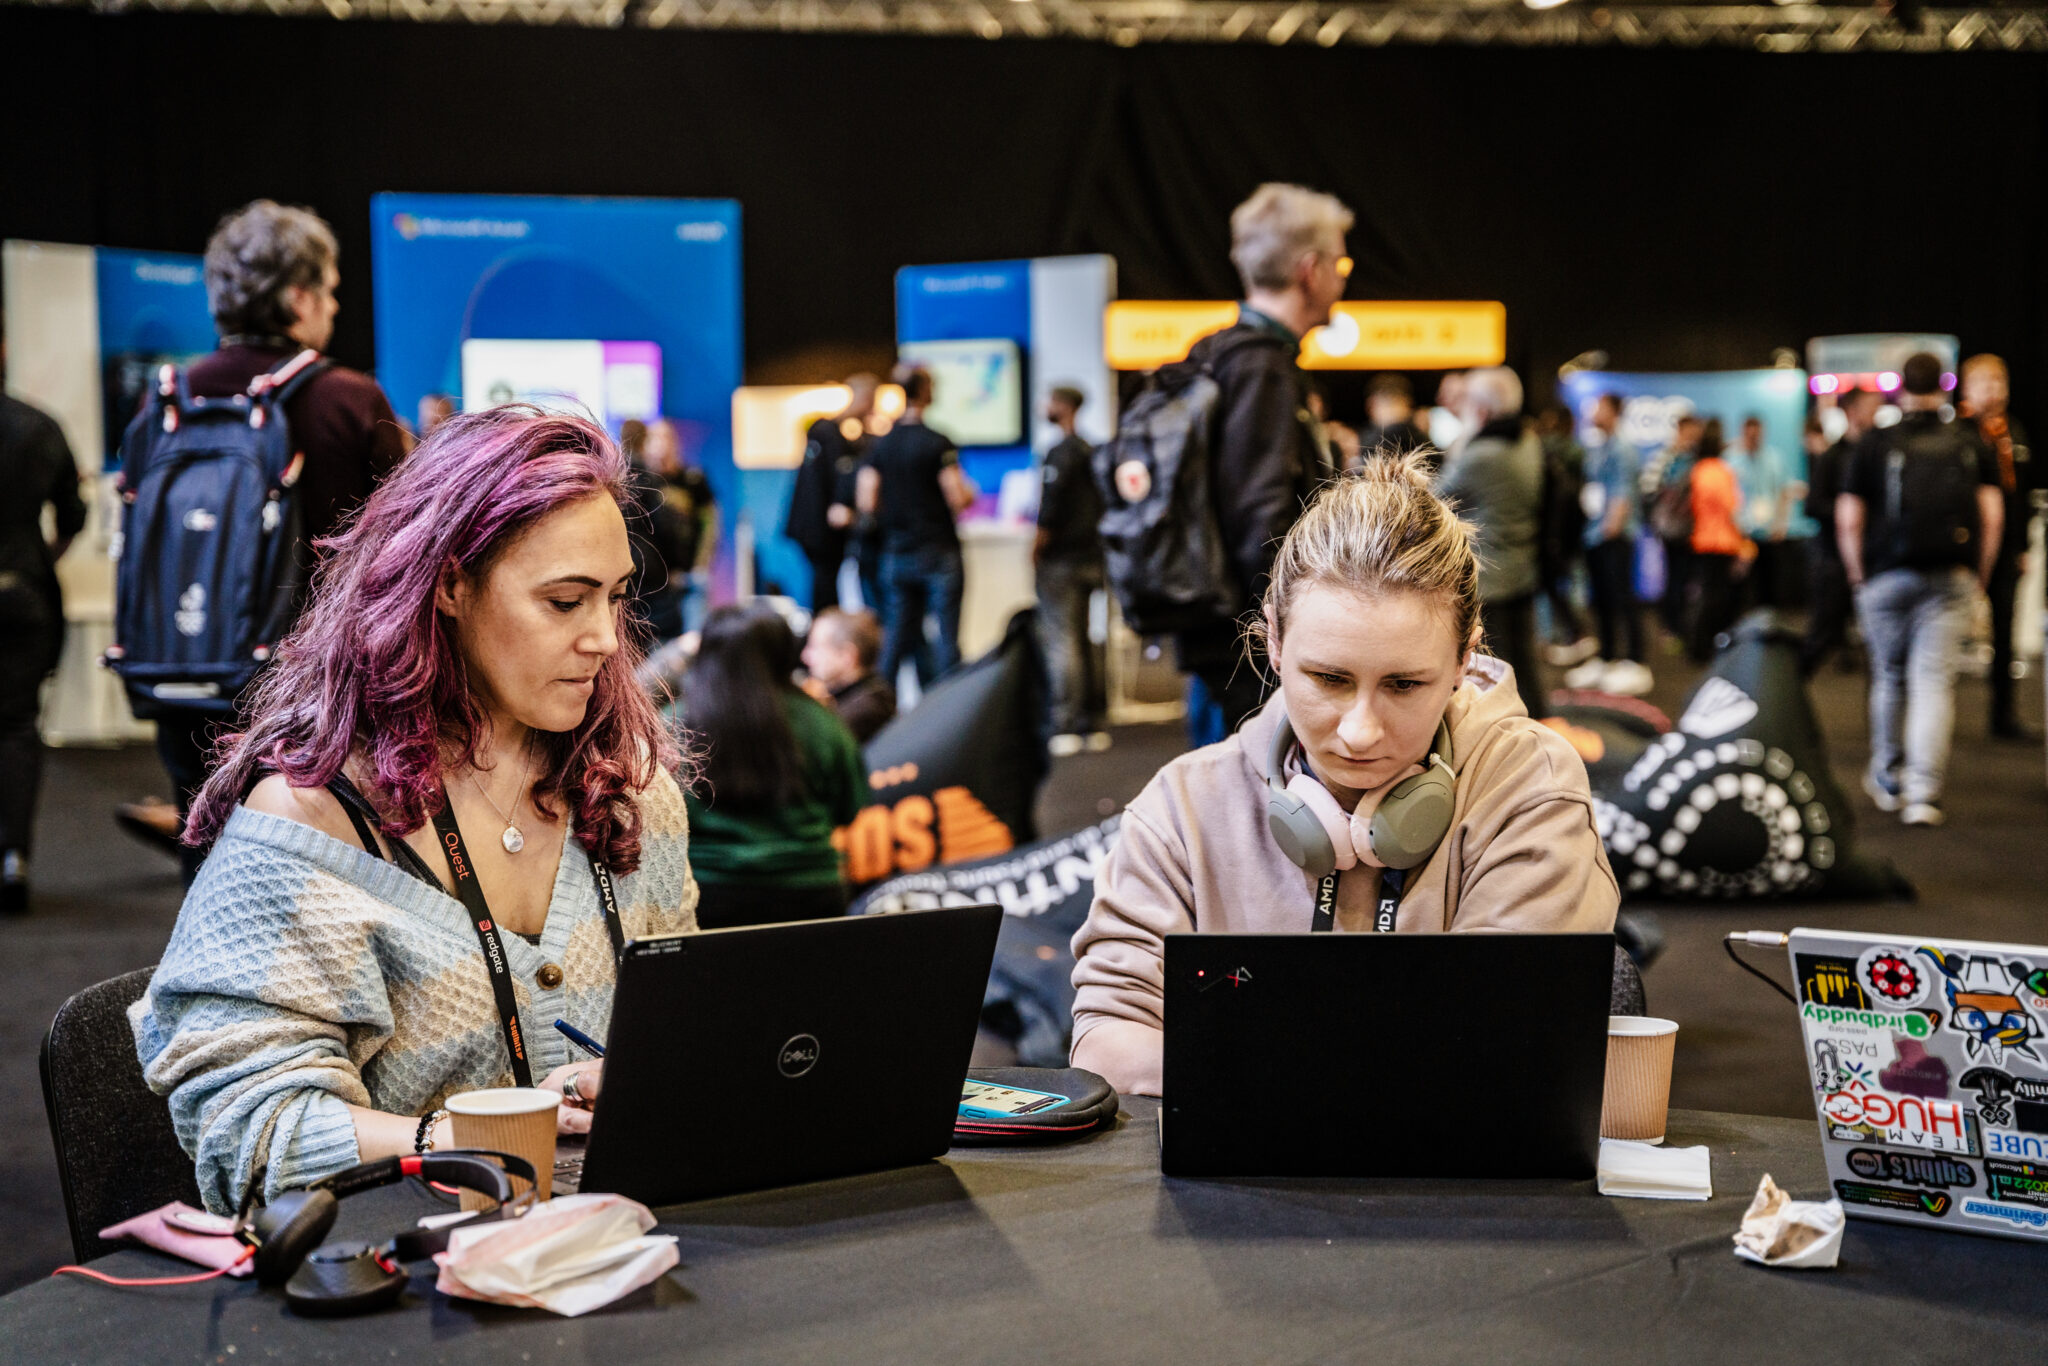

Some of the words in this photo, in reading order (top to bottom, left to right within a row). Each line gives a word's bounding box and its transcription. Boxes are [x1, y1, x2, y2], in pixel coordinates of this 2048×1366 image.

[445, 832, 470, 880] Quest
[599, 876, 616, 913] AMD
[1319, 877, 1334, 915] AMD
[485, 931, 504, 974] redgate
[511, 1024, 523, 1054] sqlbits
[783, 1049, 814, 1063] DELL
[1824, 1090, 1963, 1138] HUGO
[1889, 1128, 1966, 1151] TEAM
[1890, 1156, 1971, 1190] sqlbits
[1989, 1162, 2022, 1173] Microsoft
[2013, 1177, 2048, 1193] 2022
[1965, 1201, 2048, 1227] Swimmer
